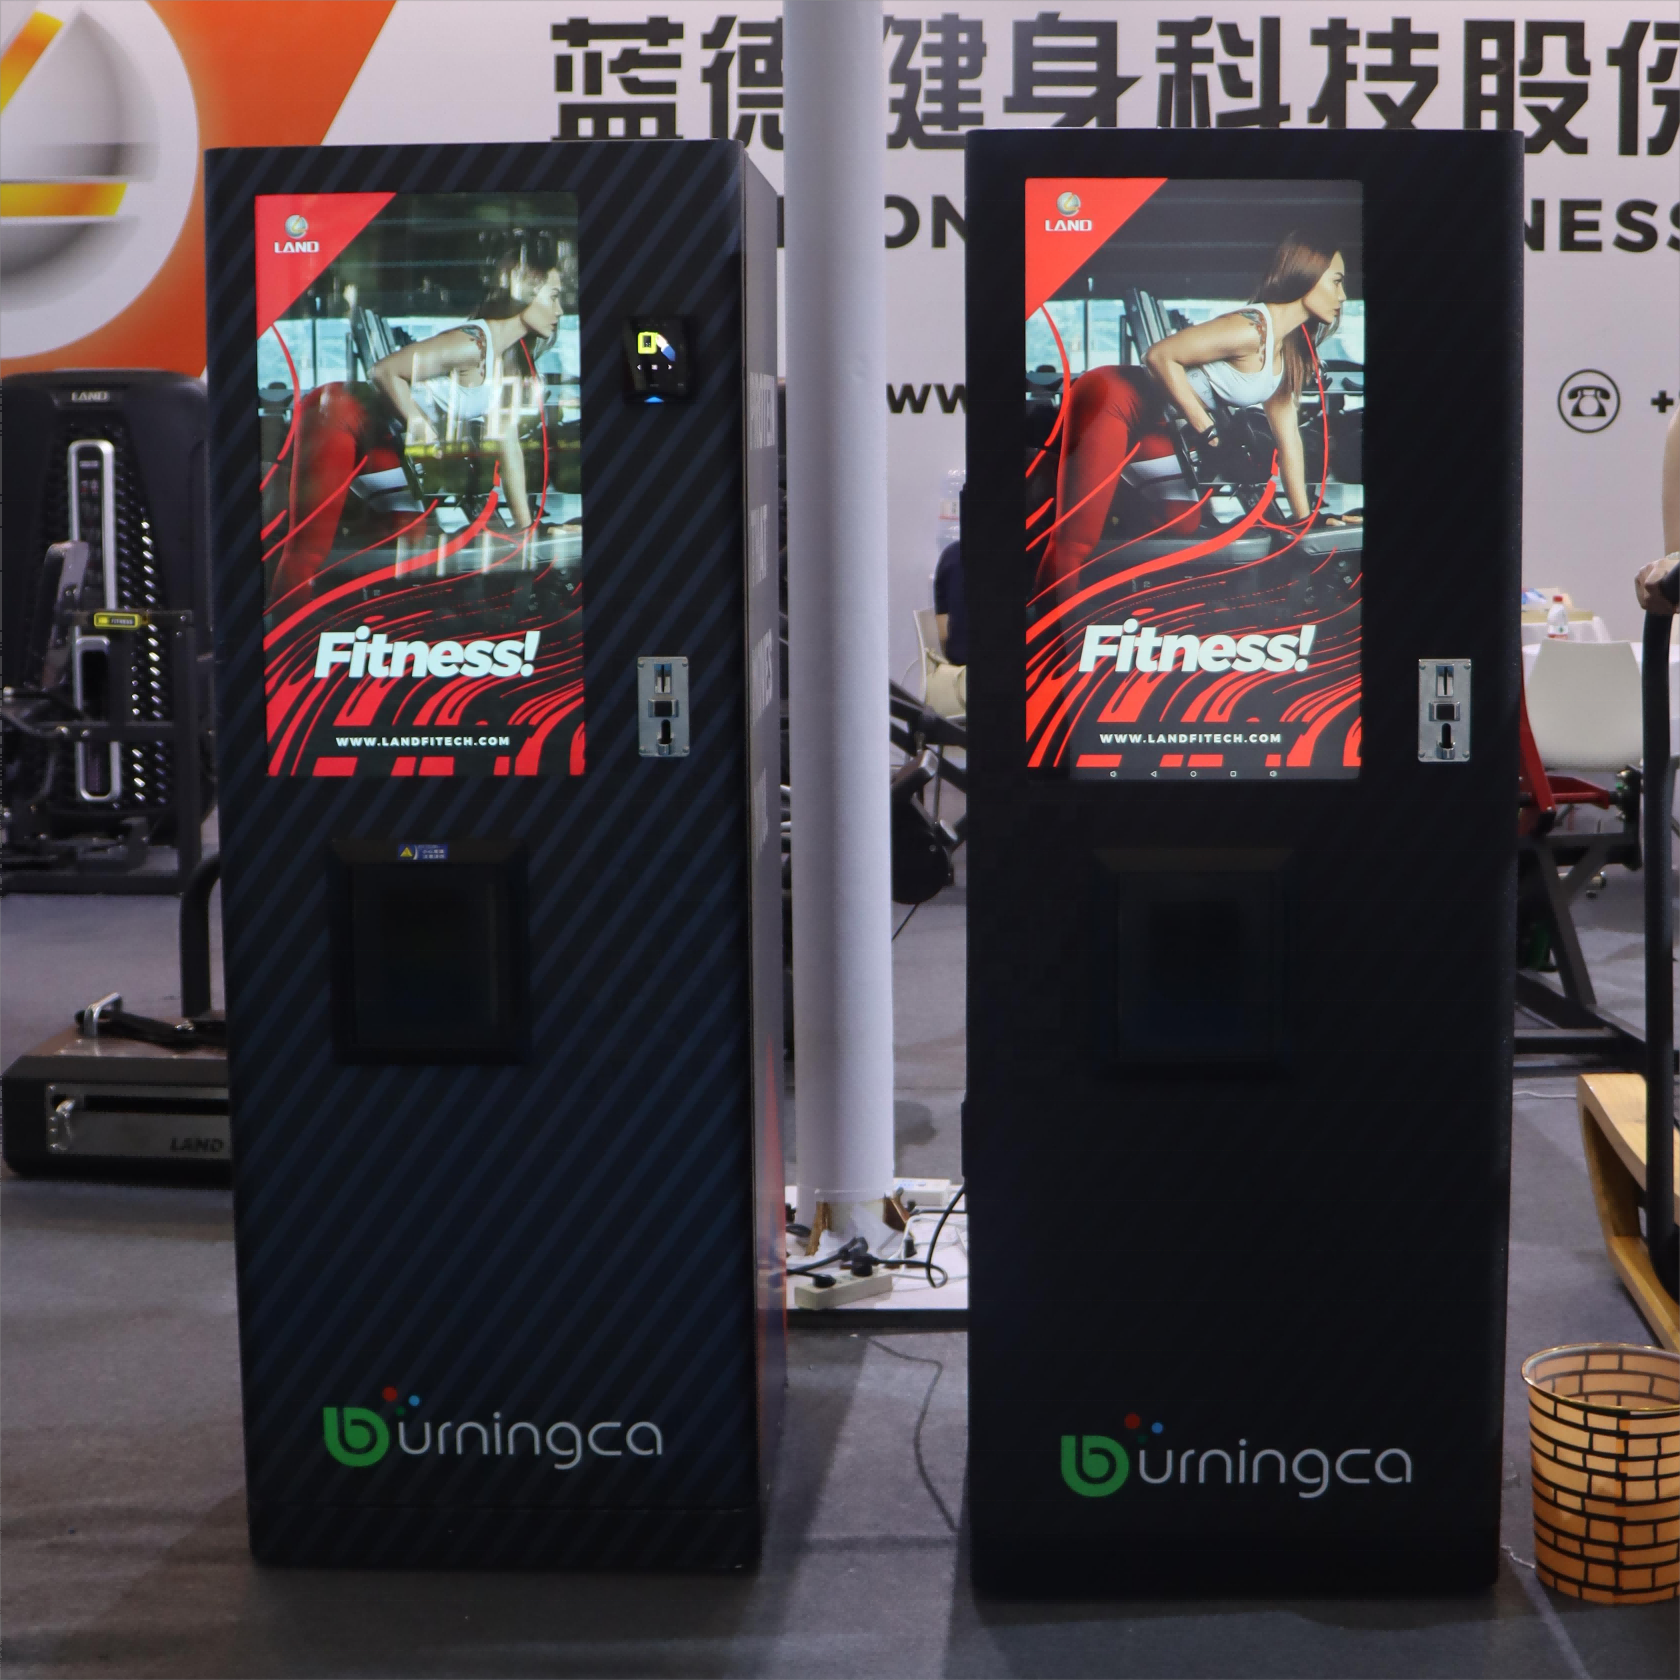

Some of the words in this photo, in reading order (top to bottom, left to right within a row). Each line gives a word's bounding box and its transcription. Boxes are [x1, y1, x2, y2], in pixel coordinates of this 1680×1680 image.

[1045, 219, 1093, 232] LAND
[1524, 198, 1680, 252] ES
[274, 241, 320, 254] LAND
[71, 390, 110, 403] LAND
[314, 625, 541, 678] Fitness!
[1078, 618, 1316, 673] Fitness!
[335, 736, 510, 747] WWW.LANDFITECH.COM
[1099, 733, 1282, 744] WWW.LANDFITECH.COM
[170, 1136, 225, 1153] LAND
